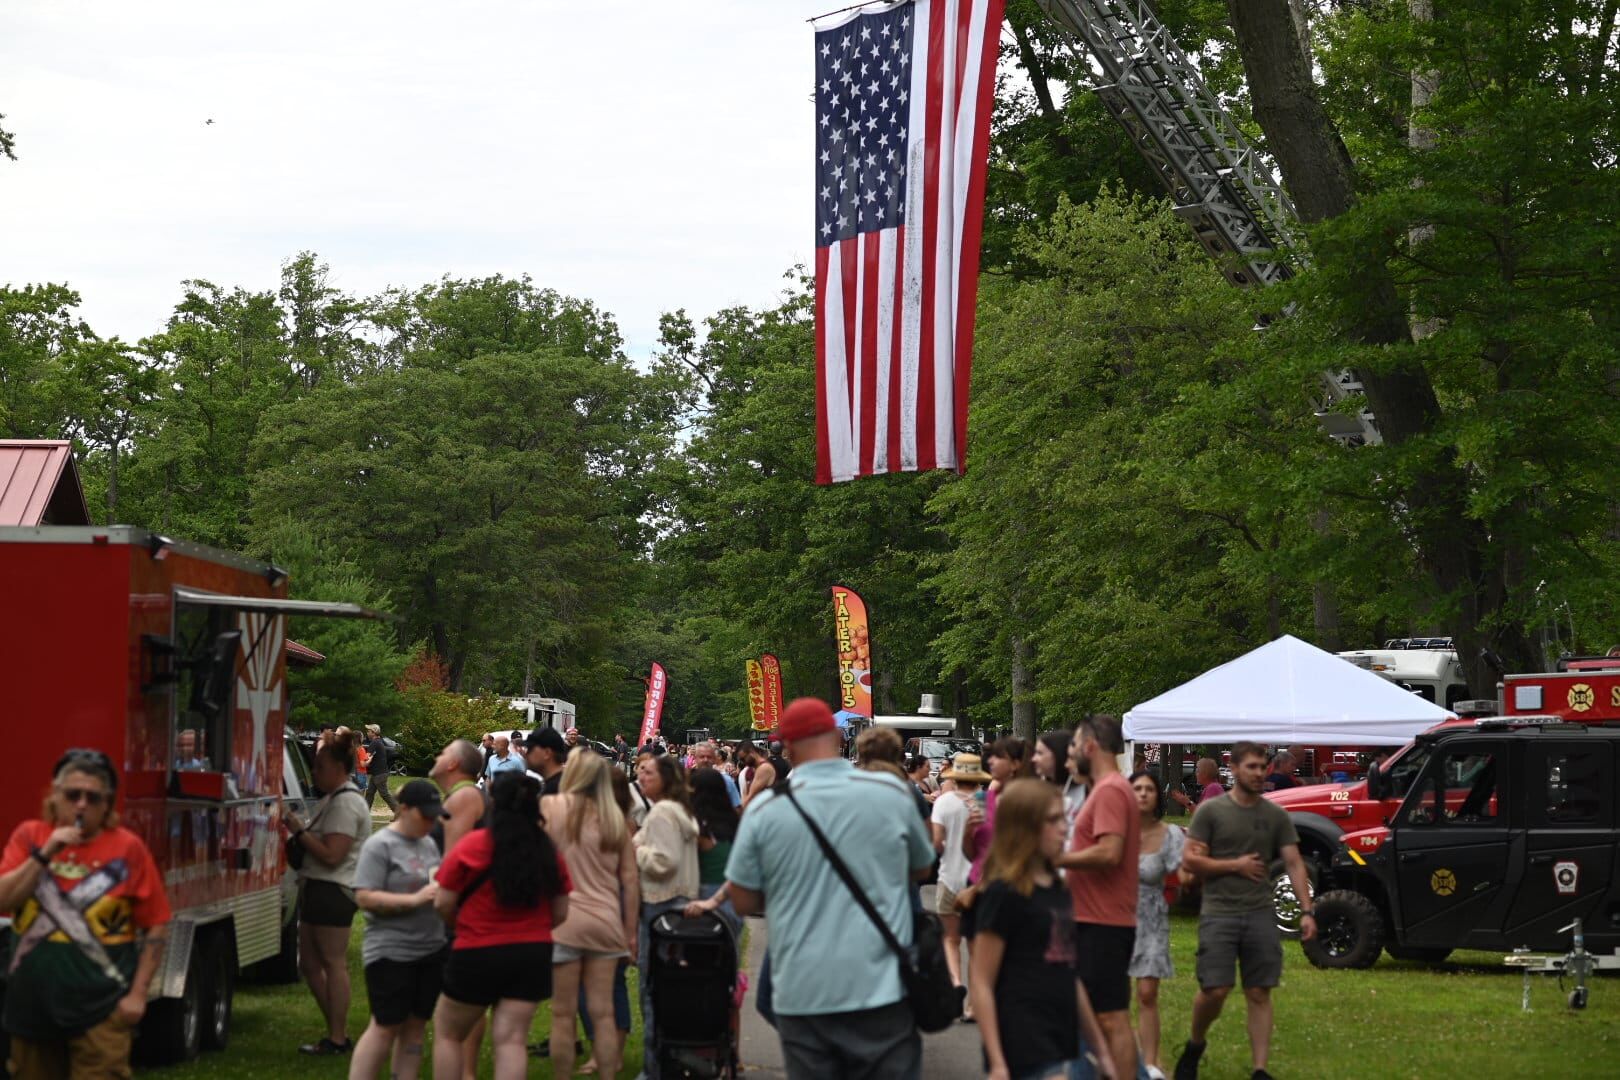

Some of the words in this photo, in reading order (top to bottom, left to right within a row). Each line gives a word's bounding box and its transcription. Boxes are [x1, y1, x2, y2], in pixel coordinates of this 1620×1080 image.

[836, 592, 851, 653] TATER
[841, 660, 856, 708] TOTS
[1575, 693, 1587, 703] SB
[1330, 791, 1350, 801] 702
